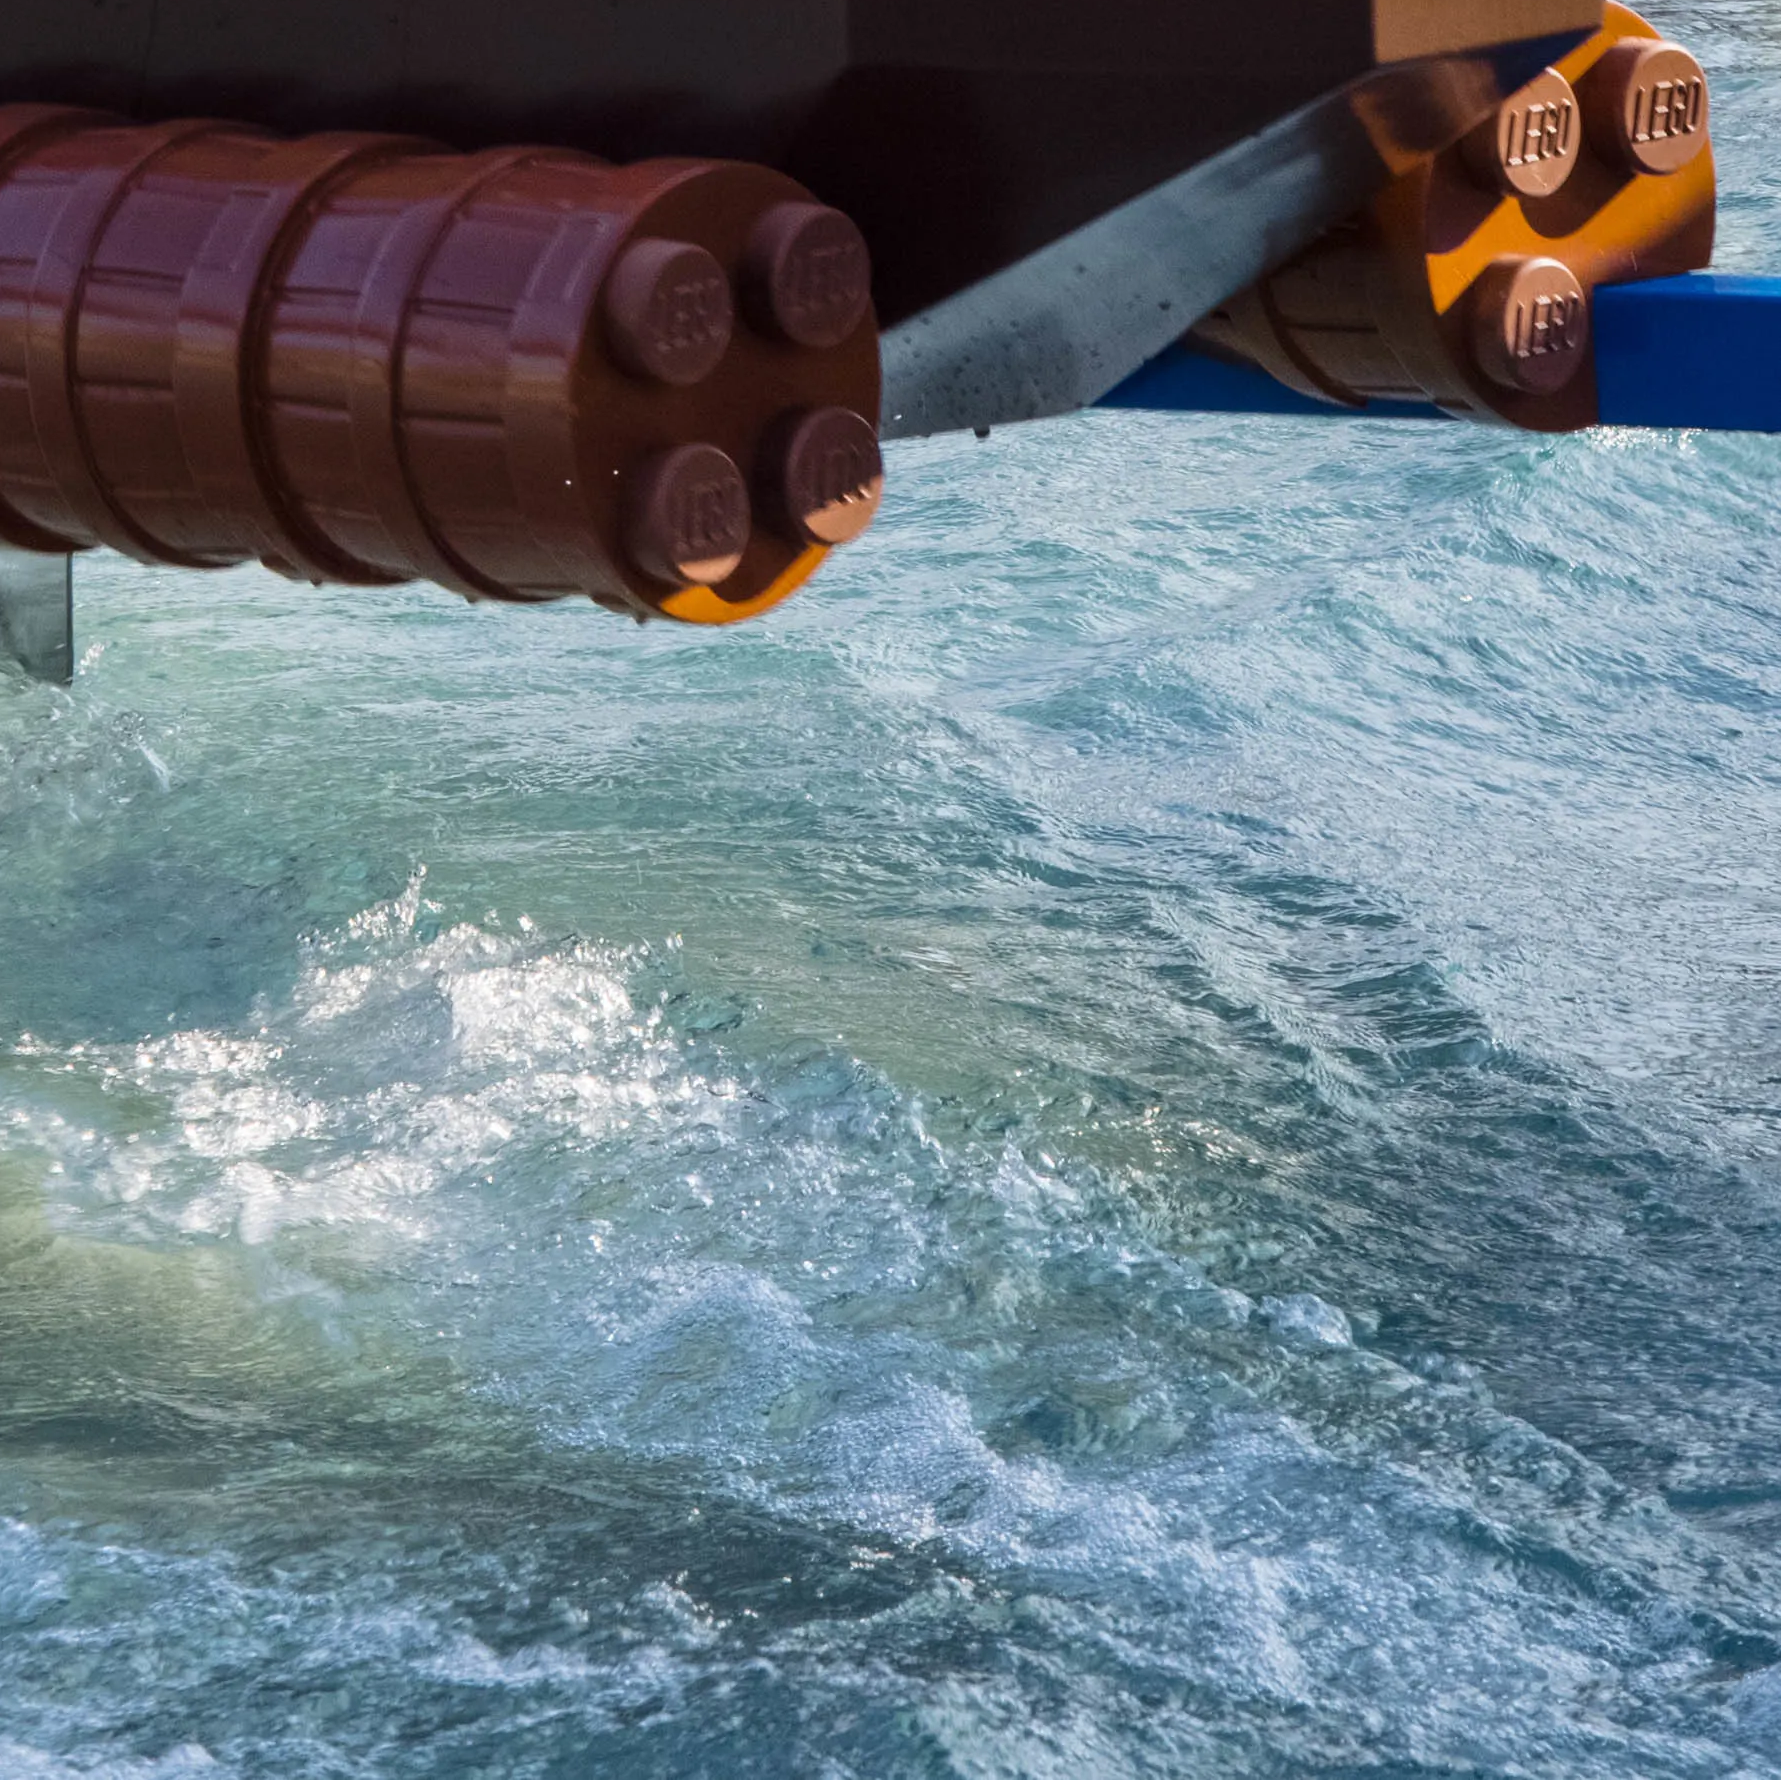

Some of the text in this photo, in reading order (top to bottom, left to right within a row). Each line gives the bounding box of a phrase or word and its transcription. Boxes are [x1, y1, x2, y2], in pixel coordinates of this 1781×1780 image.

[1506, 98, 1572, 166] LEGO
[1632, 75, 1702, 142] LEGO
[1514, 290, 1580, 357] LEGO
